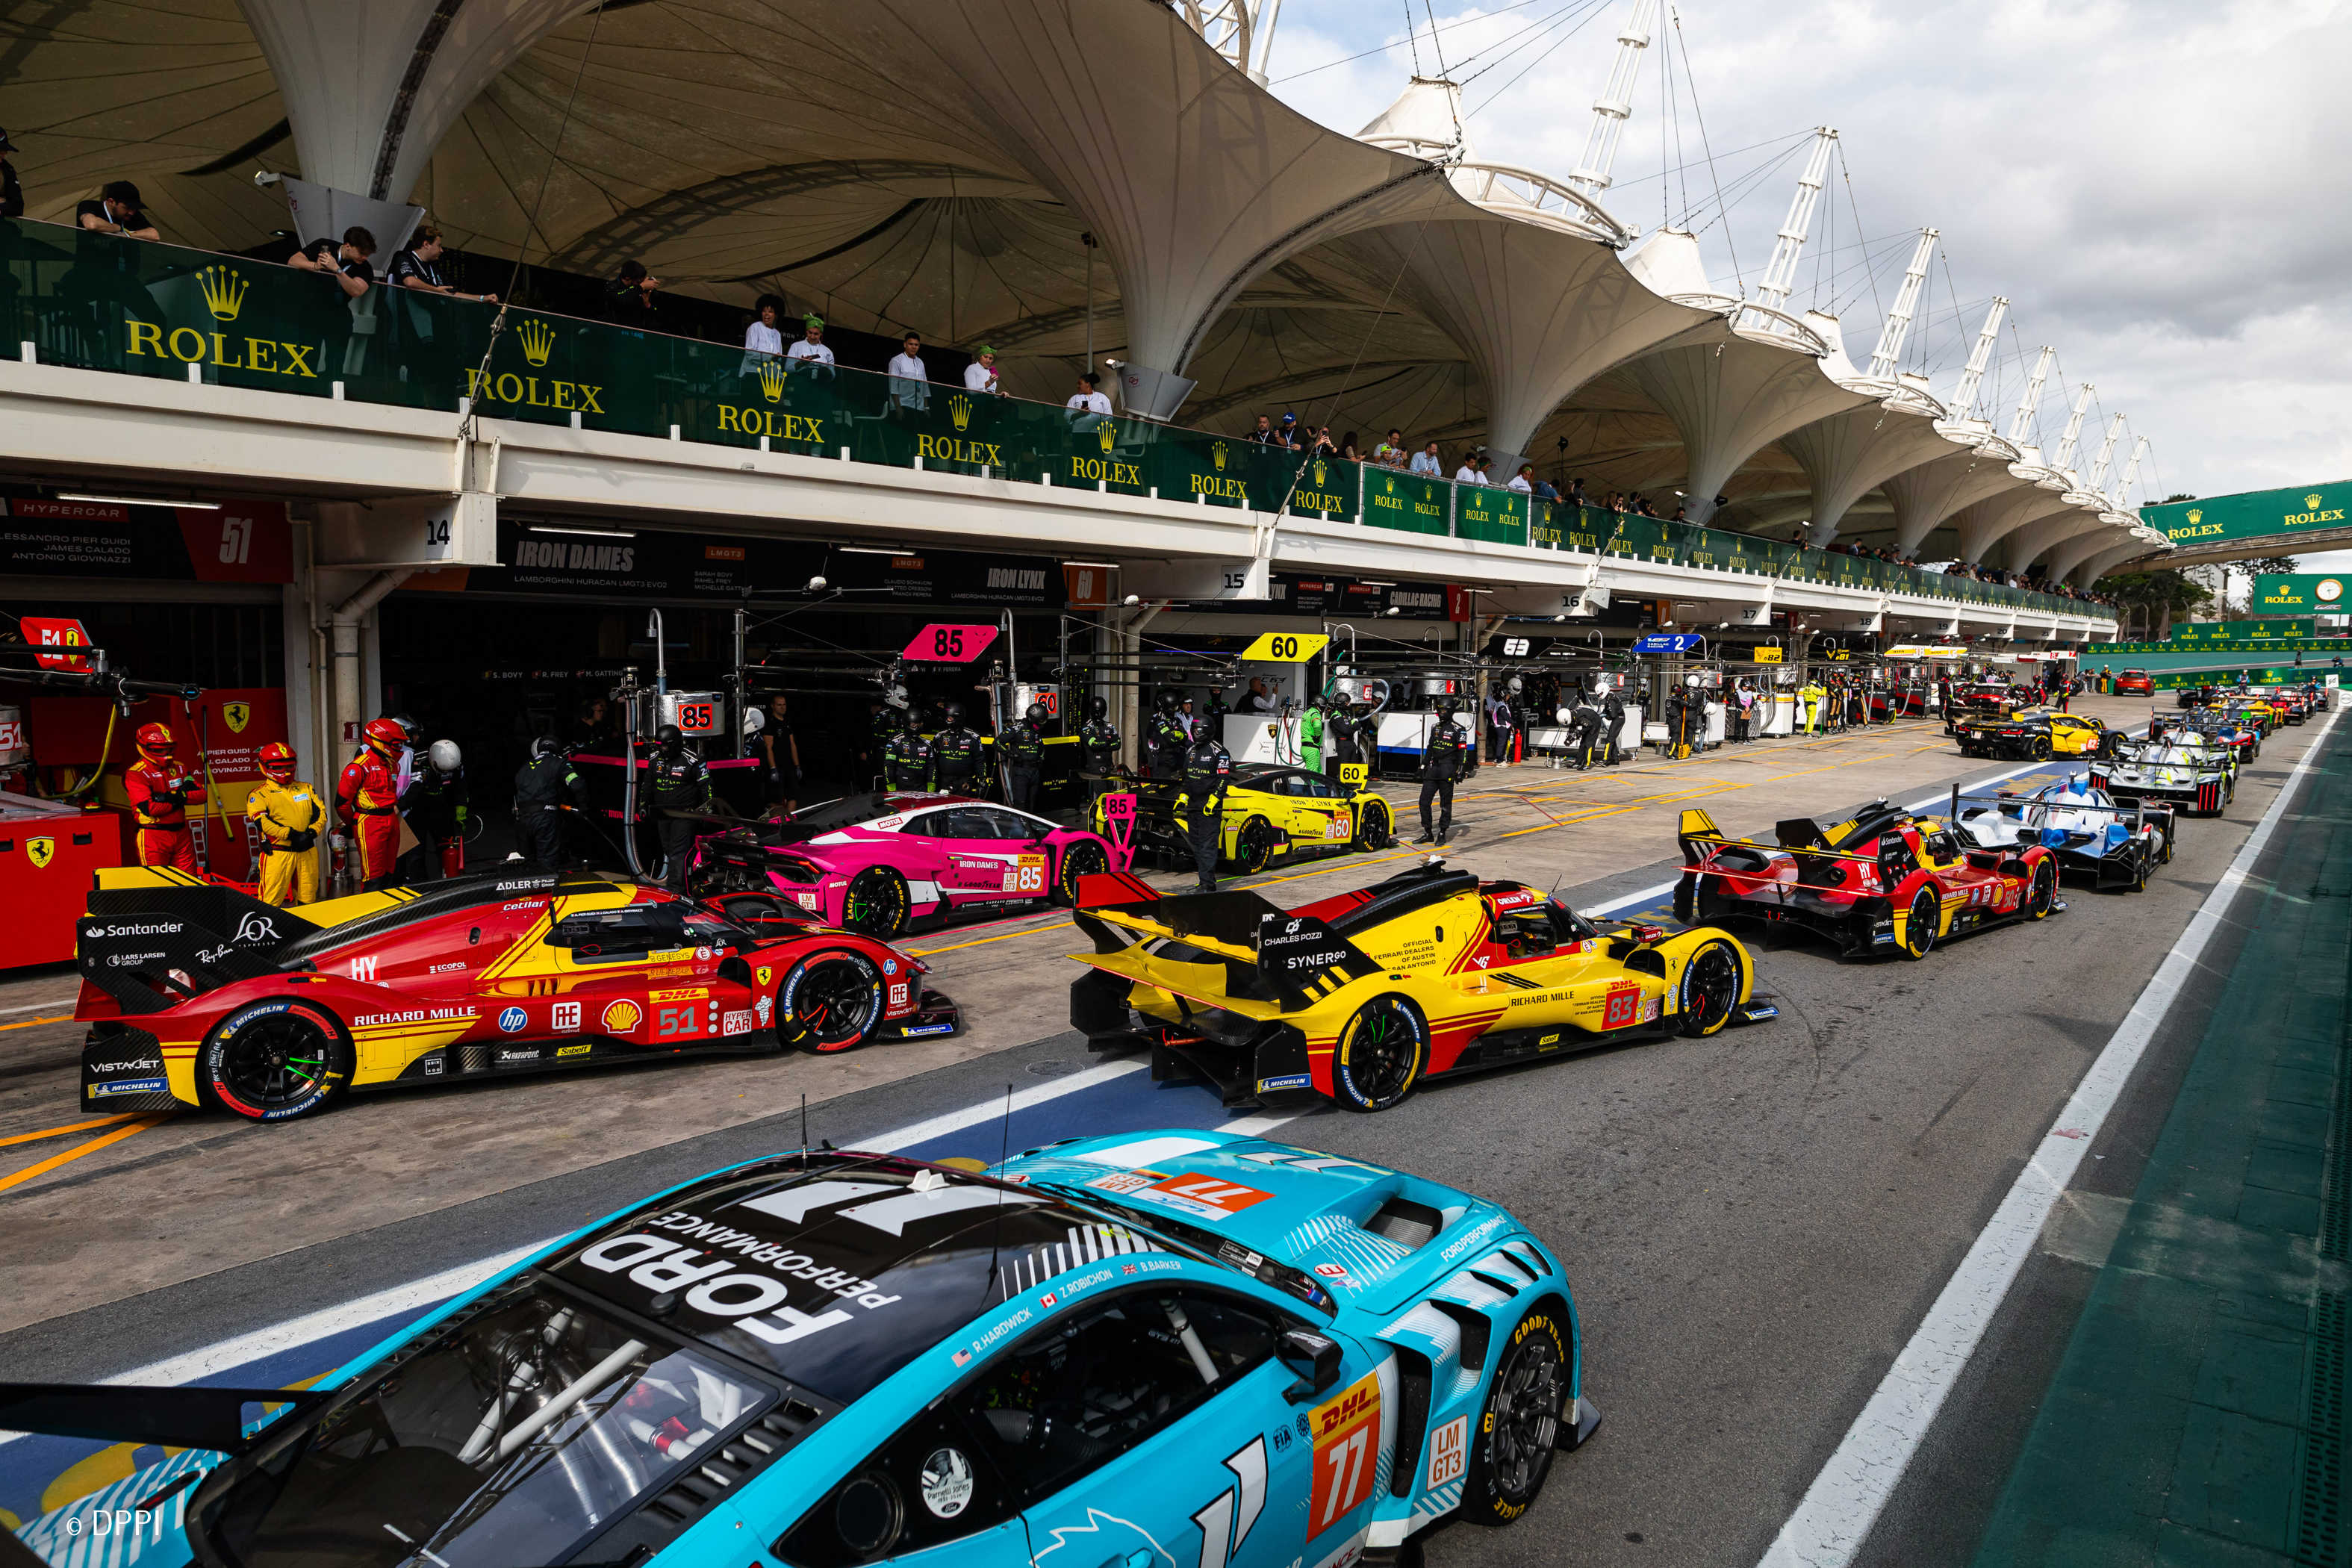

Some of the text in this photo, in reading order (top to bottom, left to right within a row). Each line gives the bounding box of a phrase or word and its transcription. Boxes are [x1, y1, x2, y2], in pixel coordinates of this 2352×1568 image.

[125, 320, 317, 377] ROLEX
[465, 369, 605, 414] ROLEX
[718, 404, 824, 444] ROLEX
[917, 434, 1002, 466] ROLEX
[1071, 456, 1140, 485] ROLEX
[1191, 474, 1247, 499] ROLEX
[1295, 490, 1343, 513] ROLEX
[1375, 495, 1403, 510] ROLEX
[1415, 502, 1440, 516] ROLEX
[24, 504, 119, 518] HYPERCAR
[1466, 509, 1489, 522] ROLEX
[2284, 509, 2345, 526] ROLEX
[1499, 514, 1519, 526] ROLEX
[427, 520, 449, 546] 14
[1532, 526, 1562, 544] ROLEX
[1569, 532, 1596, 547] ROLEX
[2168, 524, 2224, 539] ROLEX
[72, 536, 131, 546] PIER GUIDI
[220, 517, 252, 564] 51
[1608, 538, 1632, 553] ROLEX
[43, 544, 131, 555] JAMES CALADO
[515, 541, 635, 573] IRON DAMES
[710, 549, 741, 557] LMGT3
[1653, 544, 1675, 559] ROLEX
[1693, 551, 1713, 564] ROLEX
[11, 553, 131, 564] ANTONIO GIOVINAZZI
[1729, 556, 1746, 569] ROLEX
[1761, 561, 1777, 573] ROLEX
[1791, 566, 1805, 577] ROLEX
[514, 575, 575, 586] LAMBORGHINI
[618, 579, 646, 588] LMGT3
[647, 580, 668, 589] EVO2
[986, 567, 1046, 590] IRON LYNX
[1077, 570, 1093, 599] 60
[1225, 573, 1245, 588] 15
[1390, 591, 1419, 607] CADILLAC
[1419, 592, 1441, 608] RACING
[1455, 593, 1462, 614] 2
[1562, 597, 1579, 607] 16
[1743, 610, 1757, 619] 17
[42, 629, 63, 659] 51
[935, 629, 963, 656] 85
[1271, 636, 1298, 659] 60
[1503, 638, 1530, 656] 63
[1675, 636, 1684, 650] 2
[1036, 694, 1056, 714] 60
[680, 706, 711, 729] 85
[0, 721, 23, 751] 51
[2088, 739, 2097, 748] 82
[1343, 767, 1360, 780] 60
[1109, 799, 1127, 814] 85
[880, 818, 902, 829] MOTUL
[1335, 819, 1349, 837] 60
[1886, 836, 1903, 845] Santander
[959, 860, 998, 869] IRON DAMES
[1858, 862, 1870, 879] HY
[496, 880, 531, 891] ADLER
[829, 880, 847, 889] MOTUL
[963, 880, 1001, 889] GOODYEAR
[1018, 866, 1042, 890] 85
[1498, 895, 1521, 905] ORLEN
[1941, 891, 1956, 900] RICHARD
[2004, 891, 2014, 909] 50
[503, 900, 545, 912] cetilar
[892, 880, 904, 930] GOODYEAR
[107, 921, 184, 938] Santander
[1264, 931, 1322, 946] CHARLES POZZI
[1403, 939, 1433, 948] OFFICIAL
[140, 951, 166, 959] LARSEN
[196, 945, 234, 964] Ray-Ban
[656, 952, 691, 962] GENESYS
[1374, 946, 1434, 960] FERRARI DEALERS
[1411, 953, 1436, 962] AUSTIN
[351, 956, 378, 983] HY
[438, 961, 467, 971] ECOPOL
[1407, 960, 1437, 969] ANTONIO
[784, 968, 803, 1001] MICHELIN
[1683, 963, 1693, 1003] MICHELIN
[659, 989, 700, 1001] DHL
[1511, 991, 1575, 1007] RICHARD MILLE
[235, 1004, 284, 1027] MICHELIN
[355, 1006, 476, 1027] RICHARD MILLE
[724, 1010, 751, 1021] HYPER
[863, 994, 881, 1035] MICHELIN
[886, 1007, 913, 1016] VISTAJET
[1609, 995, 1634, 1023] 83
[1645, 1007, 1658, 1020] CAR
[659, 1007, 699, 1036] 51
[724, 1018, 750, 1033] CAR
[1401, 1006, 1420, 1039] MICHELIN
[560, 1045, 588, 1055] Sabelt
[90, 1057, 160, 1073] VISTAJET
[111, 1081, 161, 1092] MICHELIN
[1270, 1078, 1306, 1087] MICHELIN
[1344, 1069, 1363, 1102] MICHELIN
[267, 1097, 316, 1119] MICHELIN
[1096, 1181, 1126, 1192] LM
[1110, 1175, 1147, 1186] GT3
[1170, 1180, 1254, 1204] 77
[650, 1210, 902, 1310] PERFORMANCE
[1140, 1259, 1183, 1274] B.BARKER
[579, 1233, 853, 1345] FORD
[1059, 1267, 1113, 1300] Z.ROBICHON
[971, 1305, 1033, 1354] R.HARDWICK
[1514, 1314, 1566, 1364] GOODYEAR
[1322, 1390, 1373, 1434] DHL
[1275, 1431, 1292, 1447] FIA
[1437, 1421, 1460, 1452] LM
[1432, 1450, 1463, 1478] GT3
[1321, 1425, 1369, 1527] 77
[927, 1482, 970, 1501] Parnelli Jones
[1494, 1495, 1525, 1521] EAGLE
